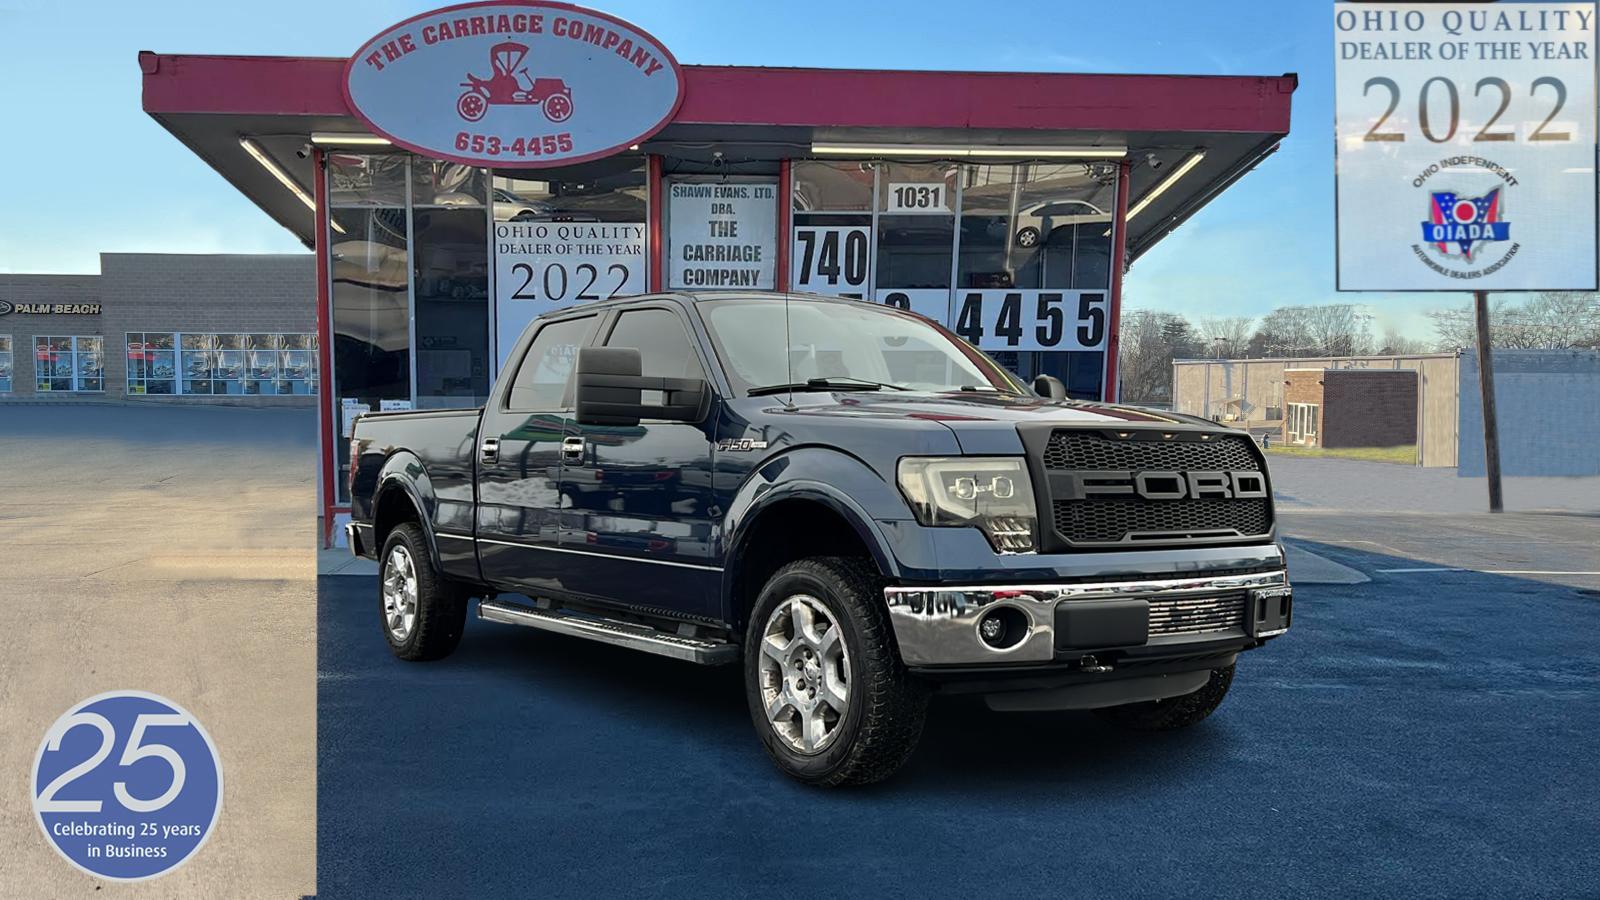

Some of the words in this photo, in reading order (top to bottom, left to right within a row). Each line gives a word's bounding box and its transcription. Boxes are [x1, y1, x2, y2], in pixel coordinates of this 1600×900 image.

[1336, 10, 1425, 31] OHIO
[1442, 10, 1593, 36] QUALITY
[365, 34, 417, 72] THE
[422, 14, 544, 46] CARRIAGE
[552, 16, 664, 77] COMPANY
[1340, 41, 1433, 60] DEALER
[1438, 41, 1469, 60] OF
[1474, 41, 1522, 60] THE
[1527, 41, 1589, 60] YEAR
[1362, 76, 1571, 143] 2022
[454, 132, 573, 156] 653-4455
[1412, 164, 1439, 188] OHIO
[1440, 156, 1519, 187] INDEPENDENT
[672, 185, 711, 198] SHAWN
[754, 187, 775, 199] LTD.
[894, 186, 940, 208] 1031
[711, 203, 736, 215] DBA.
[497, 226, 548, 239] OHIO
[557, 226, 643, 241] QUALITY
[708, 220, 738, 238] THE
[1432, 225, 1495, 240] OIADA
[499, 244, 551, 255] DEALER
[555, 244, 574, 255] OF
[575, 245, 603, 255] THE
[606, 245, 641, 256] YEAR
[683, 244, 762, 262] CARRIAGE
[797, 230, 868, 286] 740
[1411, 244, 1449, 277] AUTOMOBILE
[1449, 270, 1482, 279] DEALERS
[1483, 242, 1520, 276] ASSOCIATION
[511, 262, 630, 301] 2022
[683, 268, 761, 286] COMPANY
[15, 303, 51, 314] PALM
[54, 303, 100, 314] BEACH
[956, 292, 1105, 348] 4455
[1073, 470, 1268, 500] FORD
